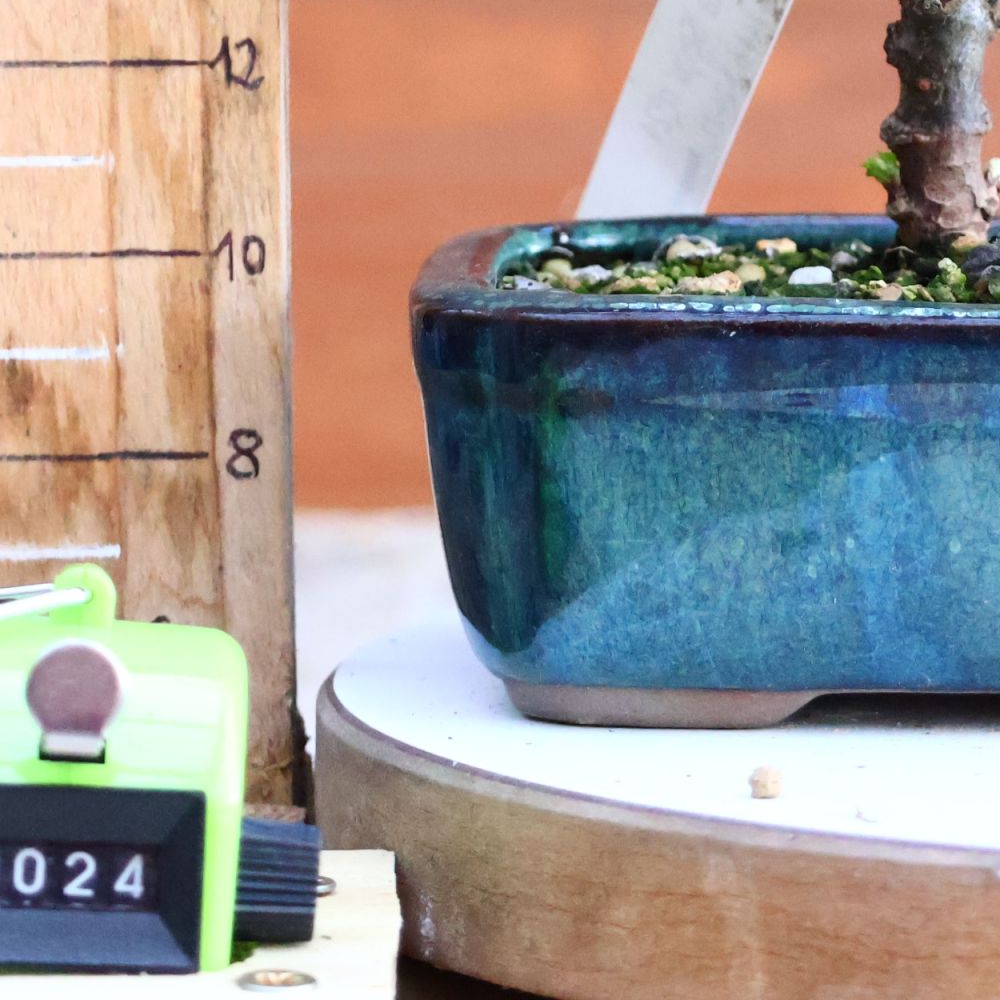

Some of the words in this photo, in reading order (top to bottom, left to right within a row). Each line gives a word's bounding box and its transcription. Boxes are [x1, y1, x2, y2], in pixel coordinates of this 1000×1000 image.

[208, 36, 265, 90] 12
[212, 231, 266, 281] 10
[226, 428, 263, 479] 8
[13, 847, 145, 898] 024
